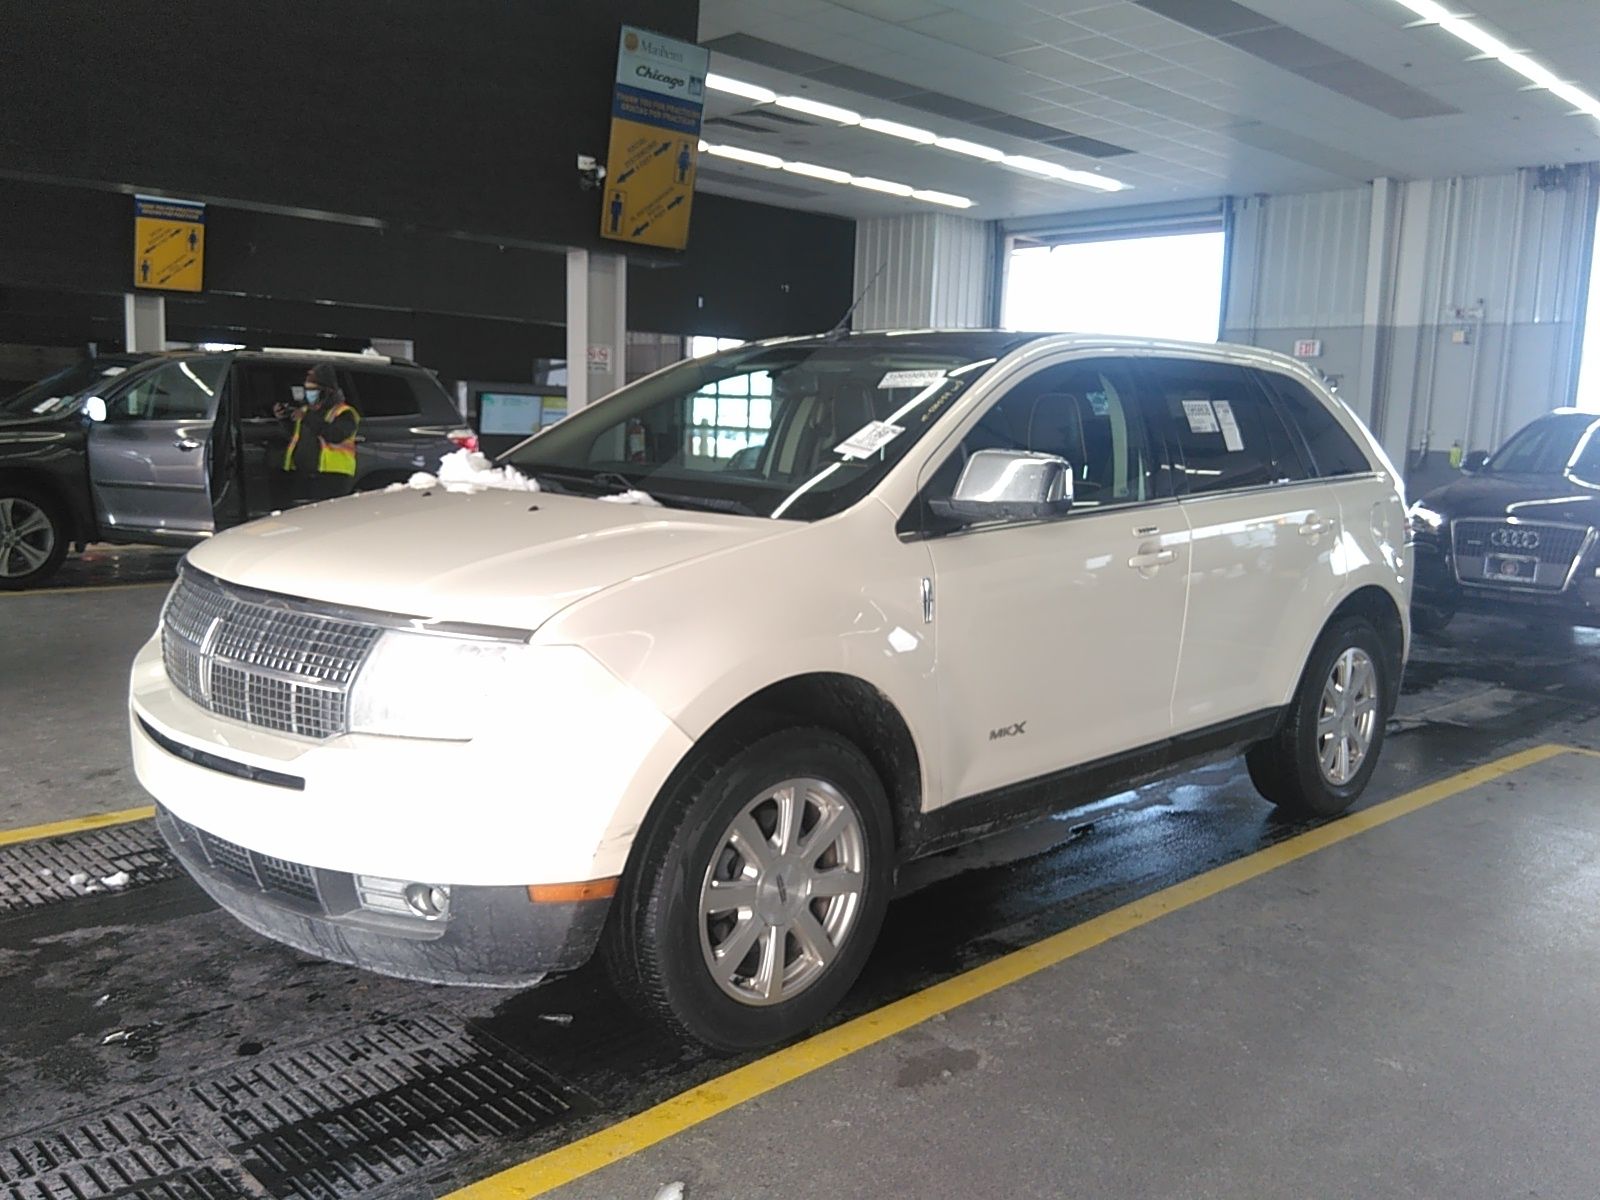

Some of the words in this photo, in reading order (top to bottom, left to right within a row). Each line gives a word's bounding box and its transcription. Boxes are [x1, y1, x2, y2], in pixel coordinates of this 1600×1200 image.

[635, 65, 685, 89] Chicago
[1299, 341, 1316, 356] EXIT
[989, 720, 1027, 741] MKX
